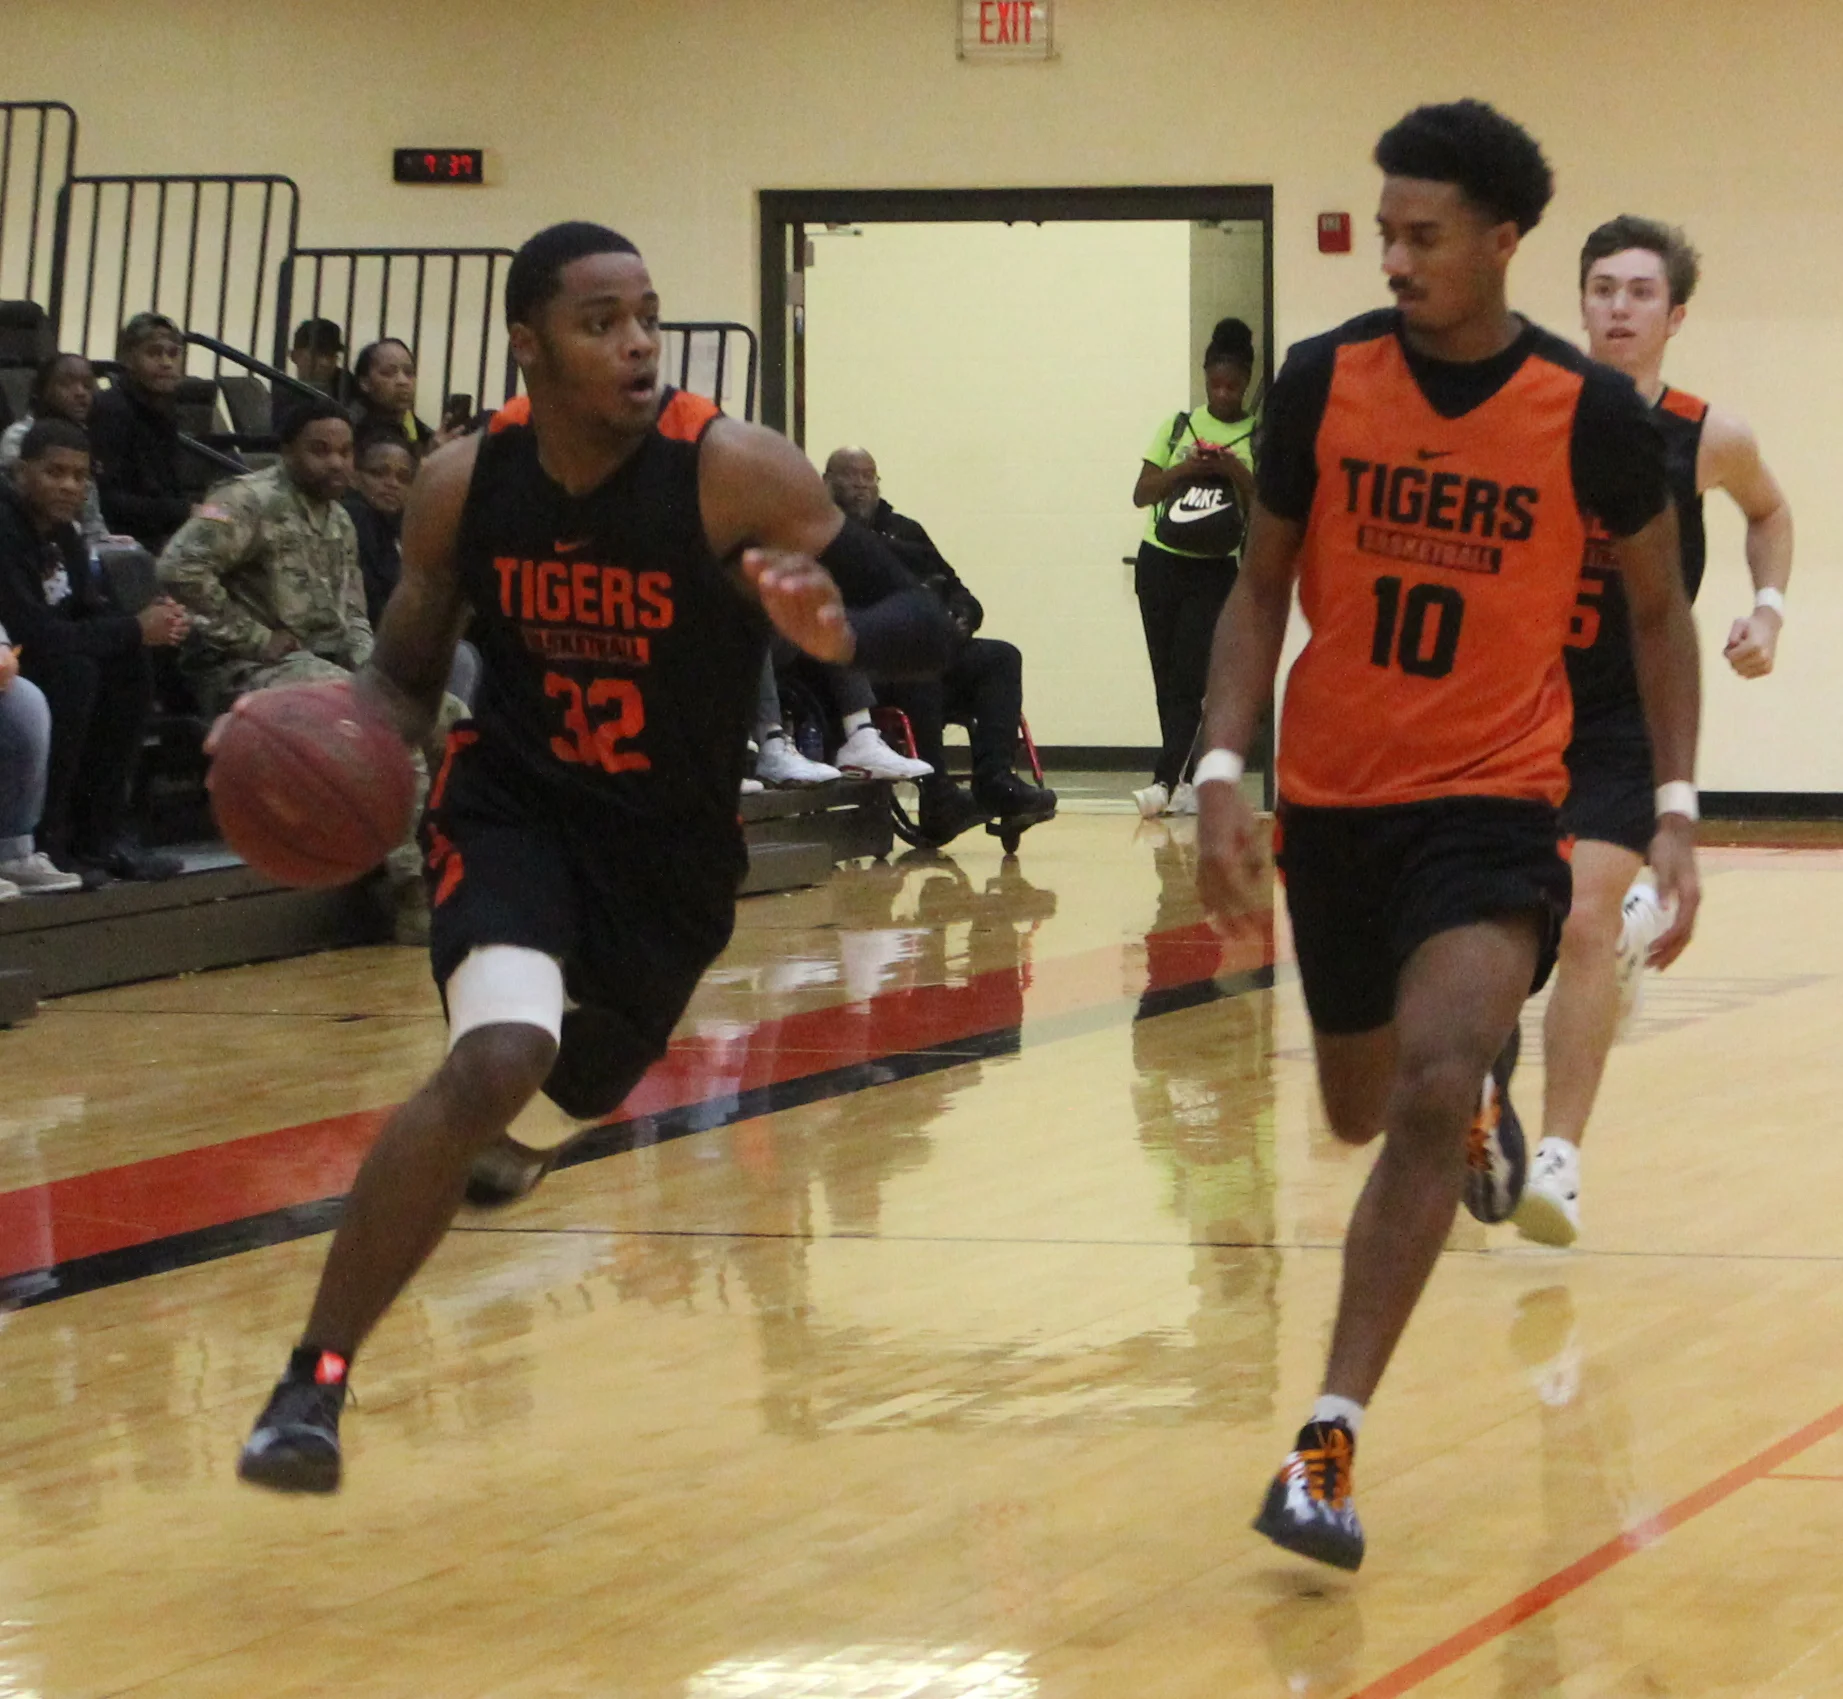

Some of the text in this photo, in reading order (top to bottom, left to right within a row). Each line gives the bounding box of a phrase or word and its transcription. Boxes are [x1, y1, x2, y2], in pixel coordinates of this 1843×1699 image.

[980, 1, 1035, 44] EXIT
[1181, 486, 1223, 509] NIKE
[1340, 457, 1540, 541] TIGERS
[494, 556, 674, 629] TIGERS
[1369, 575, 1465, 680] 10
[544, 672, 650, 773] 32
